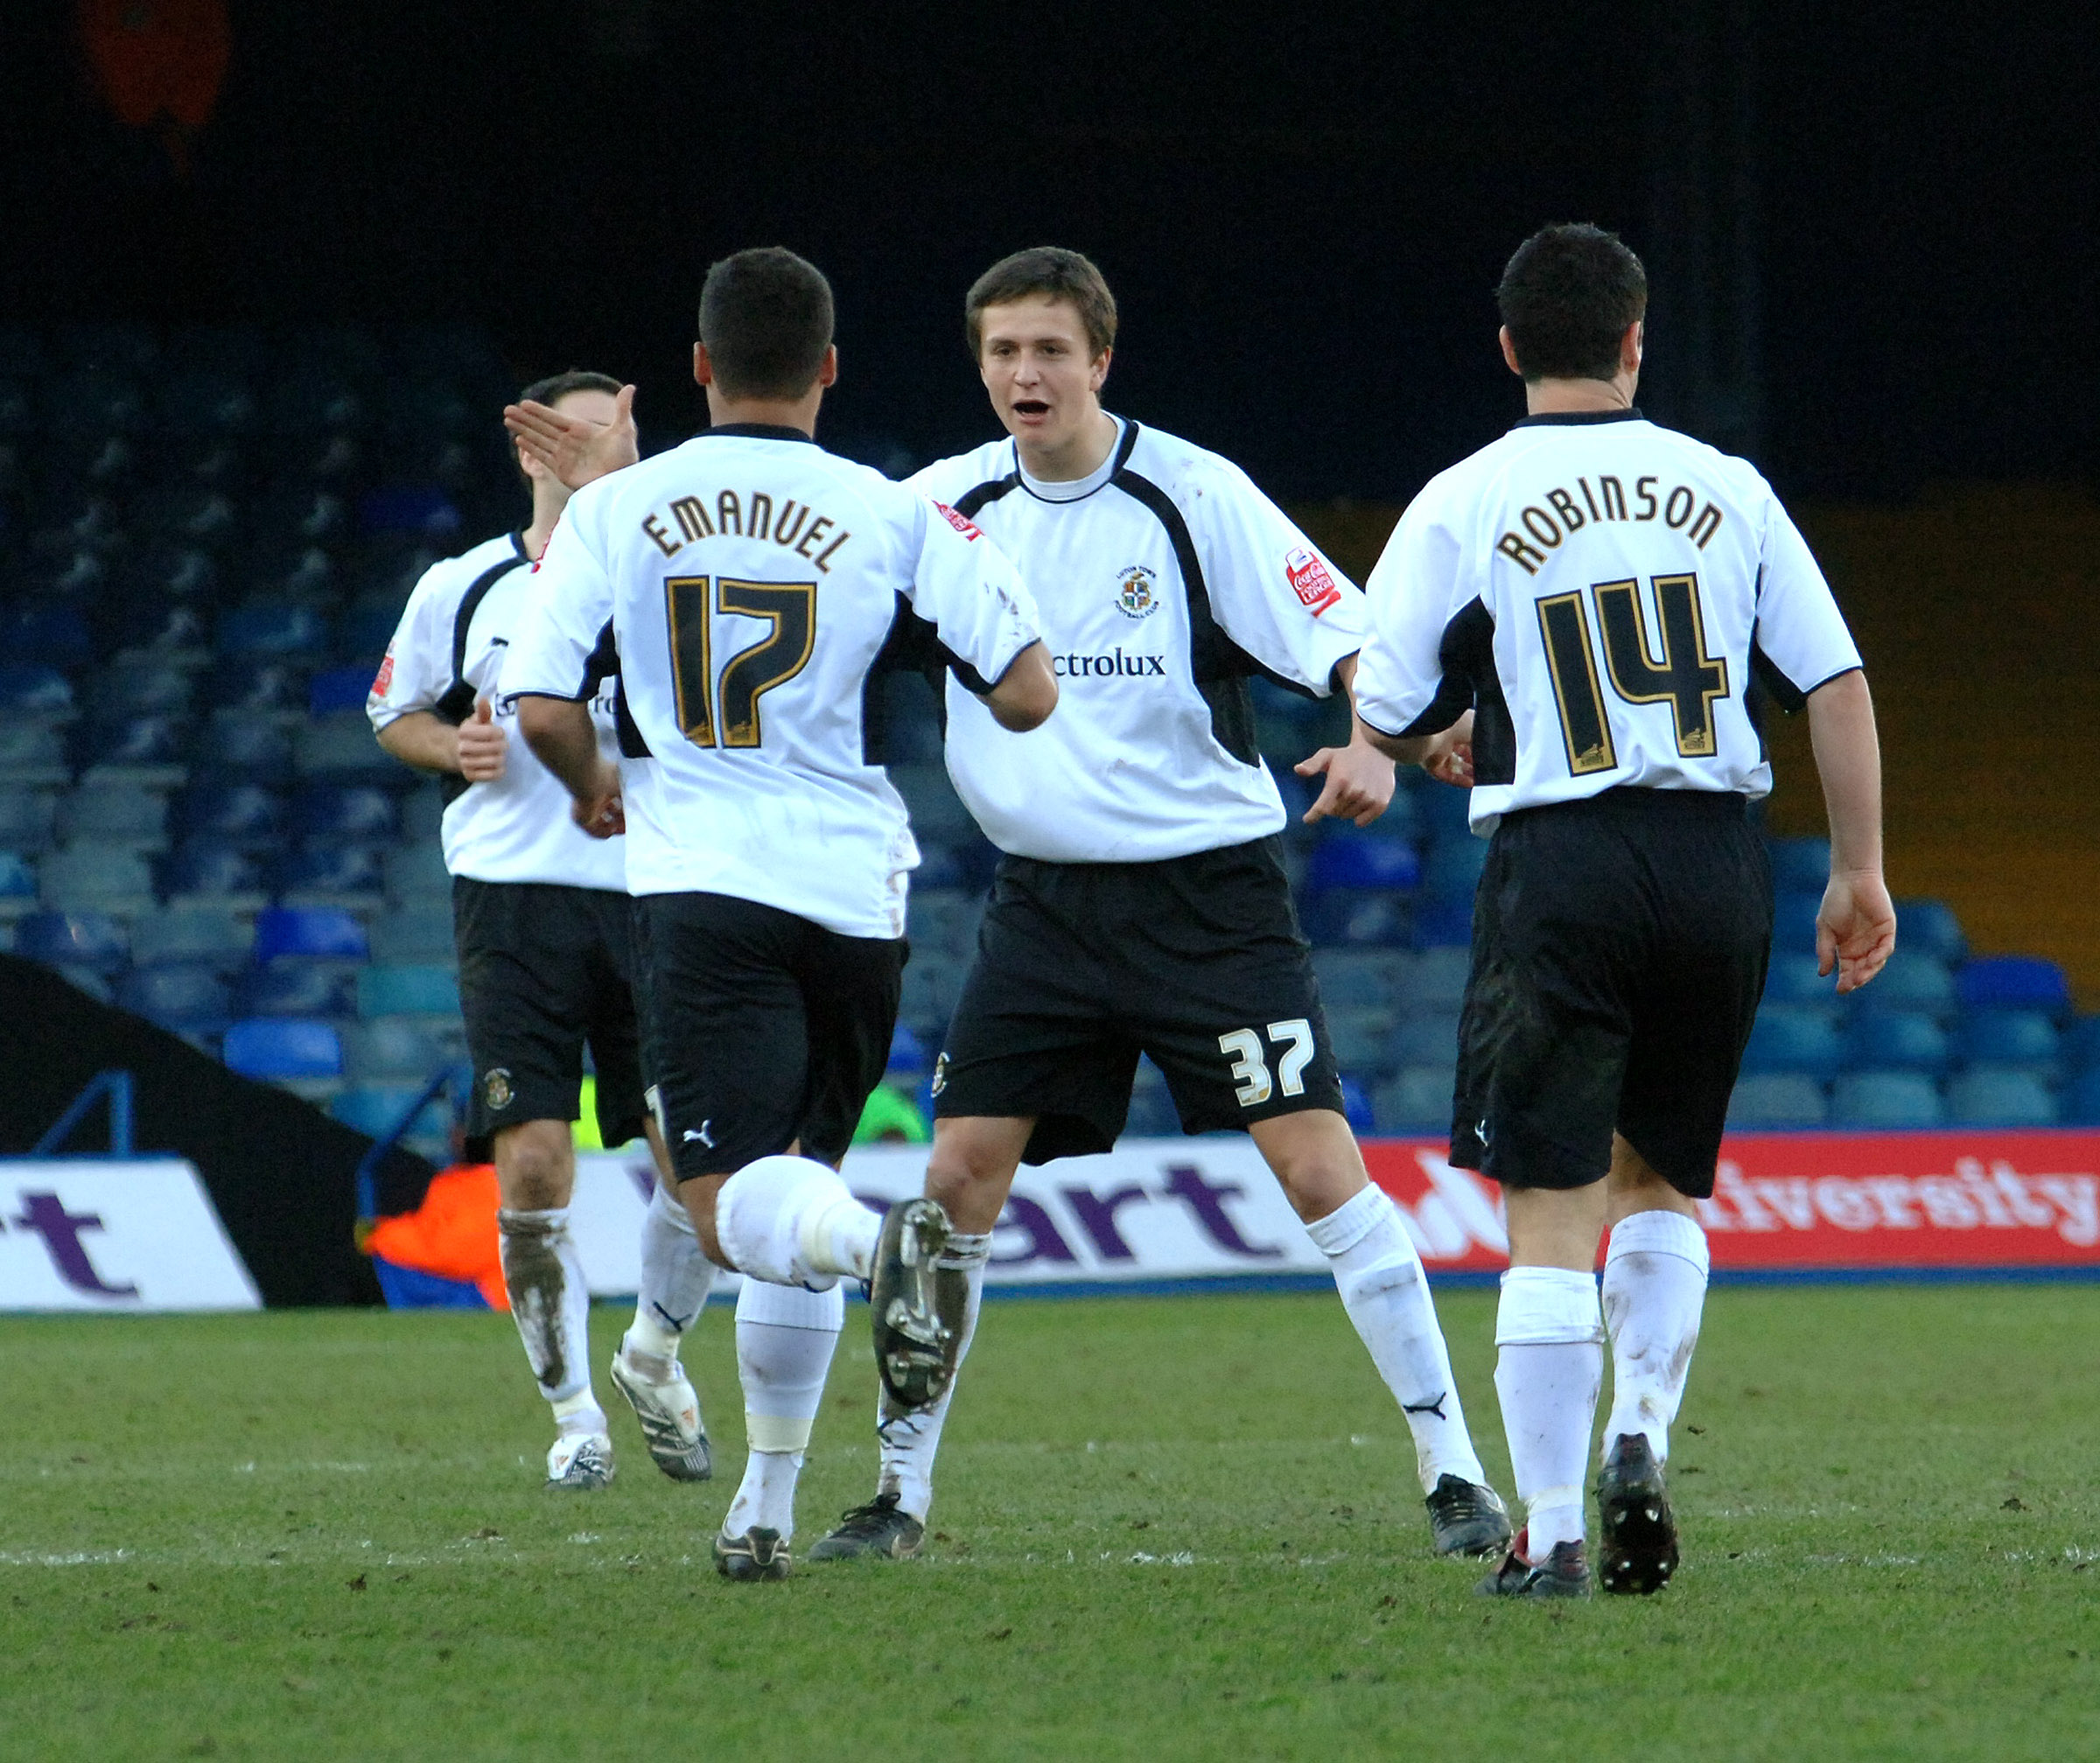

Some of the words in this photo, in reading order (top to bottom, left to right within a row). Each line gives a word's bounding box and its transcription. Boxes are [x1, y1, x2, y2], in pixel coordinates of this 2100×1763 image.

[640, 488, 850, 576] EMANUEL
[1496, 475, 1724, 577] ROBINSON
[662, 574, 817, 749] 17
[1053, 647, 1166, 677] ctrolux
[1534, 571, 1731, 778] 14
[1218, 1018, 1314, 1107] 37
[1700, 1157, 2097, 1247] iversity
